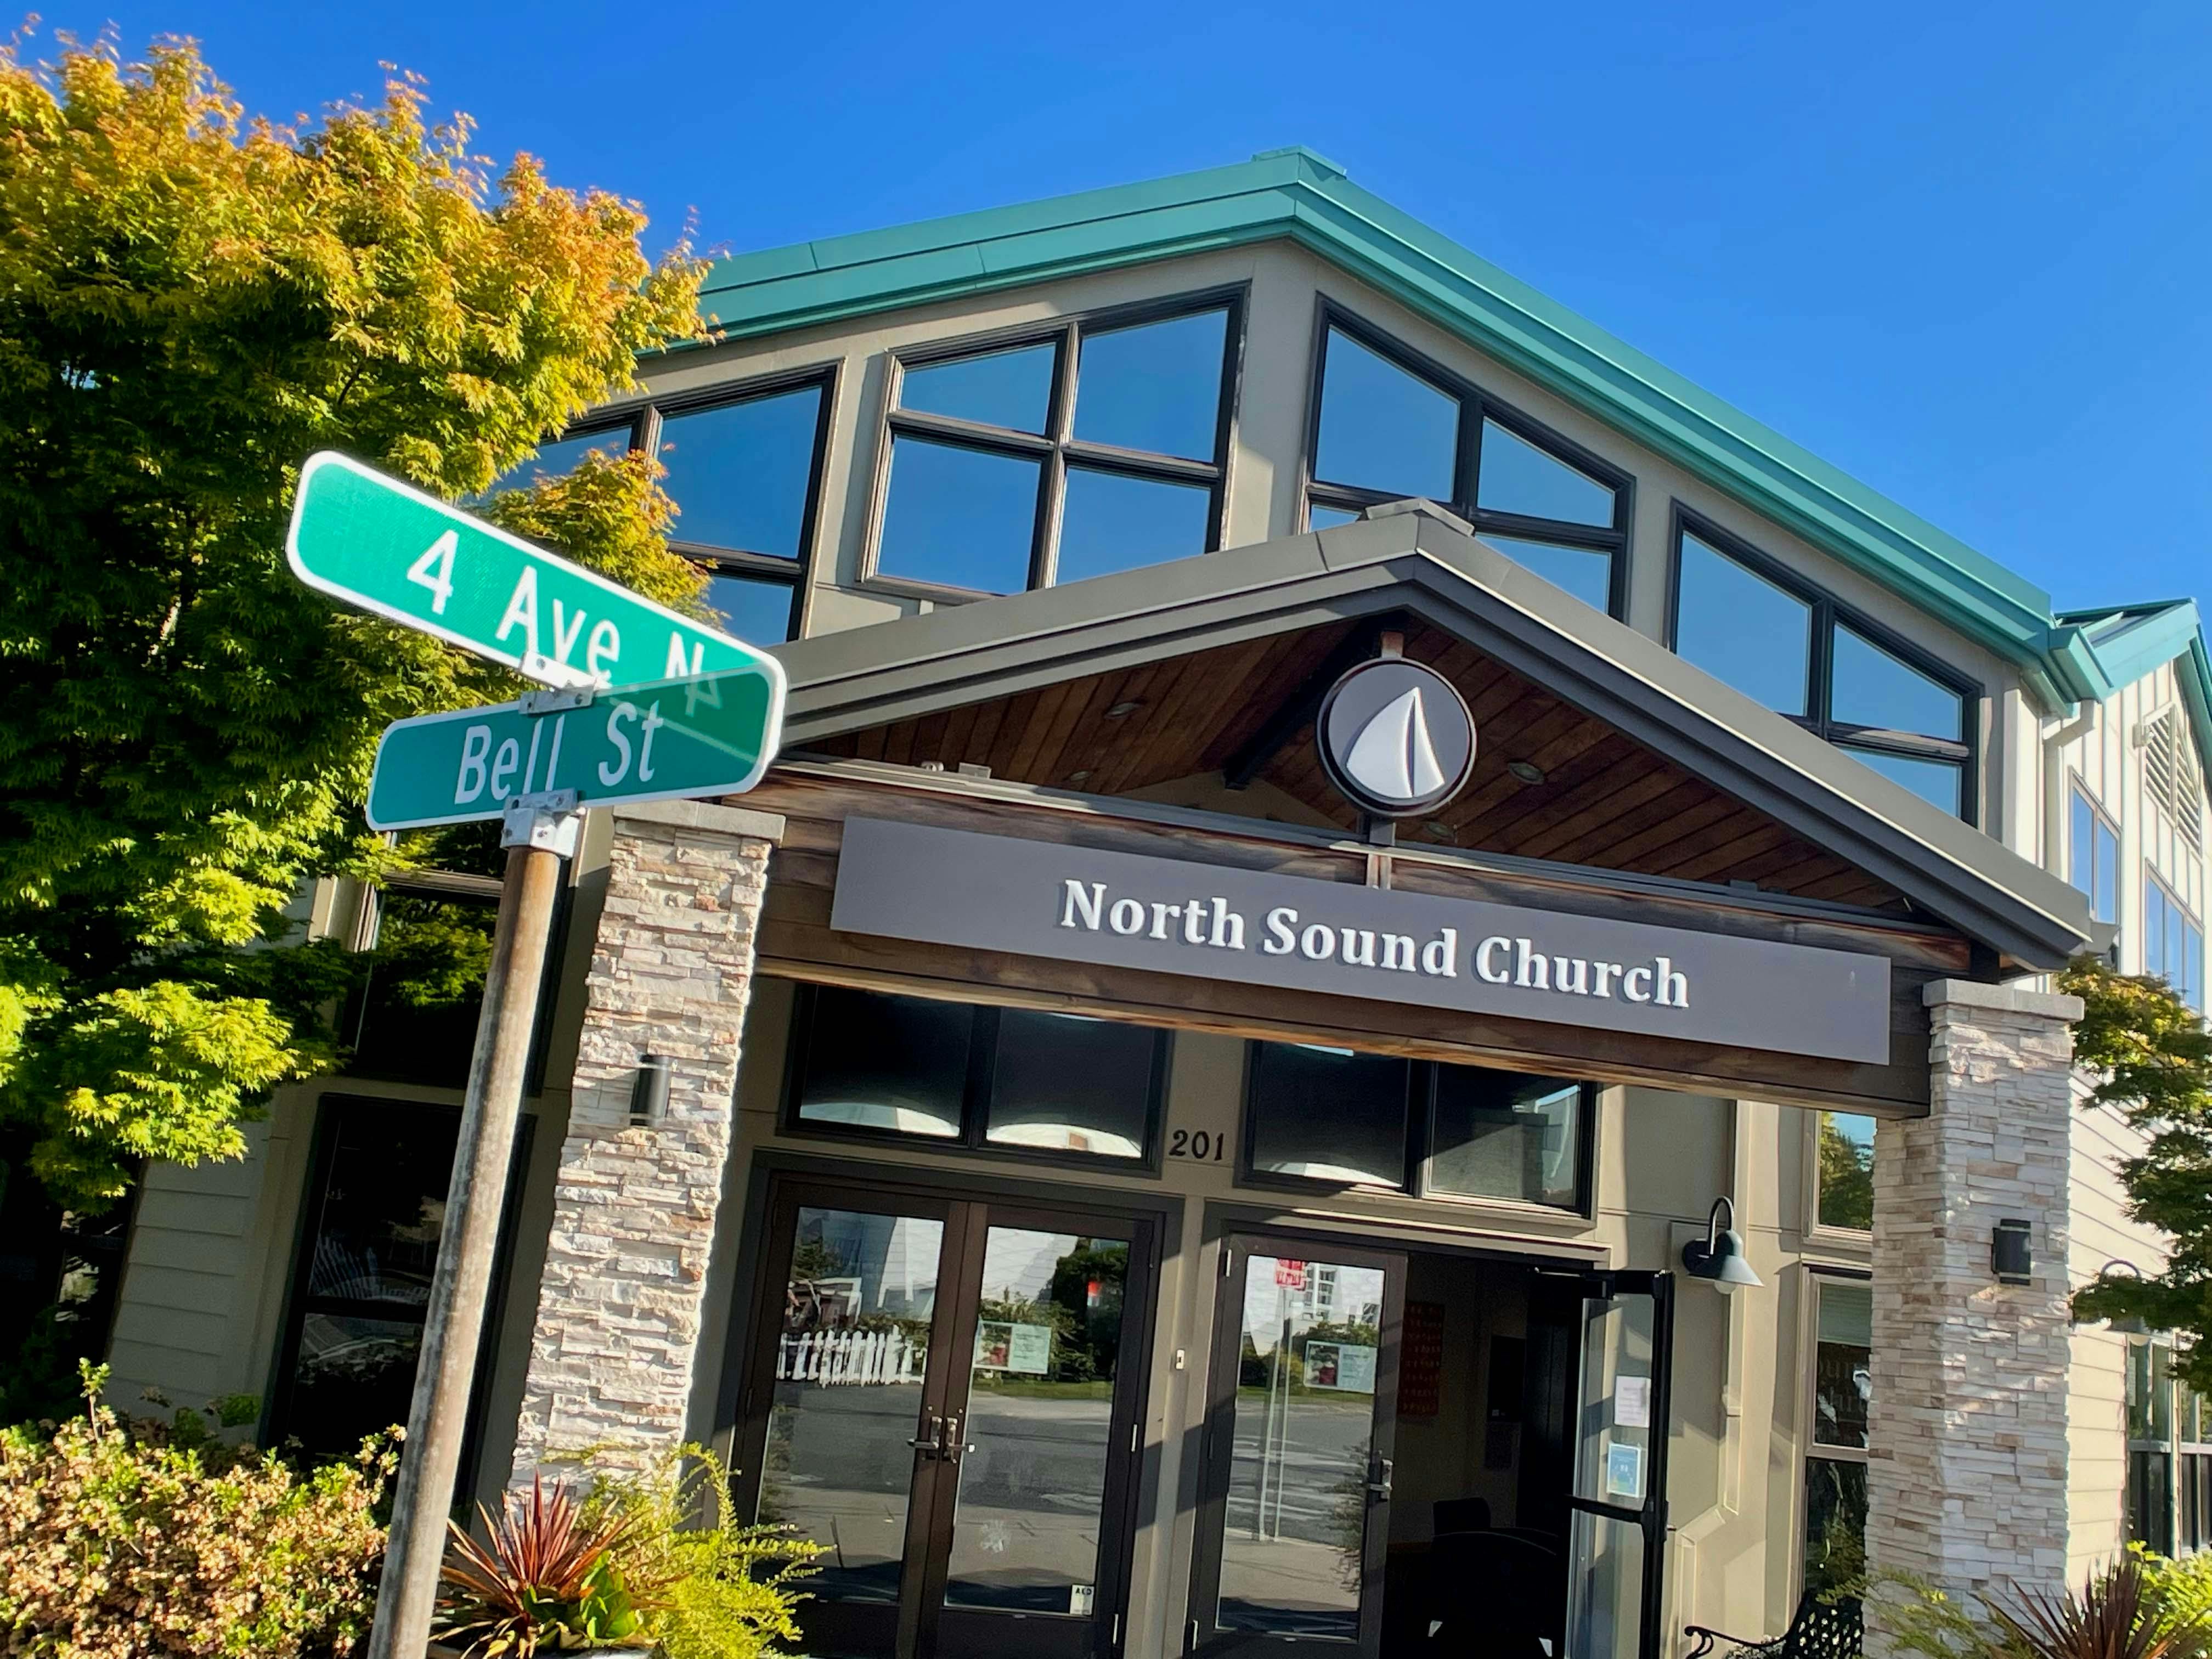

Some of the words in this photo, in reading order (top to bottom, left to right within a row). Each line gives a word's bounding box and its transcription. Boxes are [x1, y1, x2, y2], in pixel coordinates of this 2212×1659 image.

[407, 529, 459, 615] 4
[495, 565, 620, 681] Ave
[665, 631, 705, 681] N
[454, 714, 566, 805] Bell
[598, 699, 664, 787] St
[1060, 879, 1246, 950] North
[1263, 907, 1458, 978] Sound
[1475, 935, 1690, 1008] Church
[1169, 1129, 1224, 1161] 201
